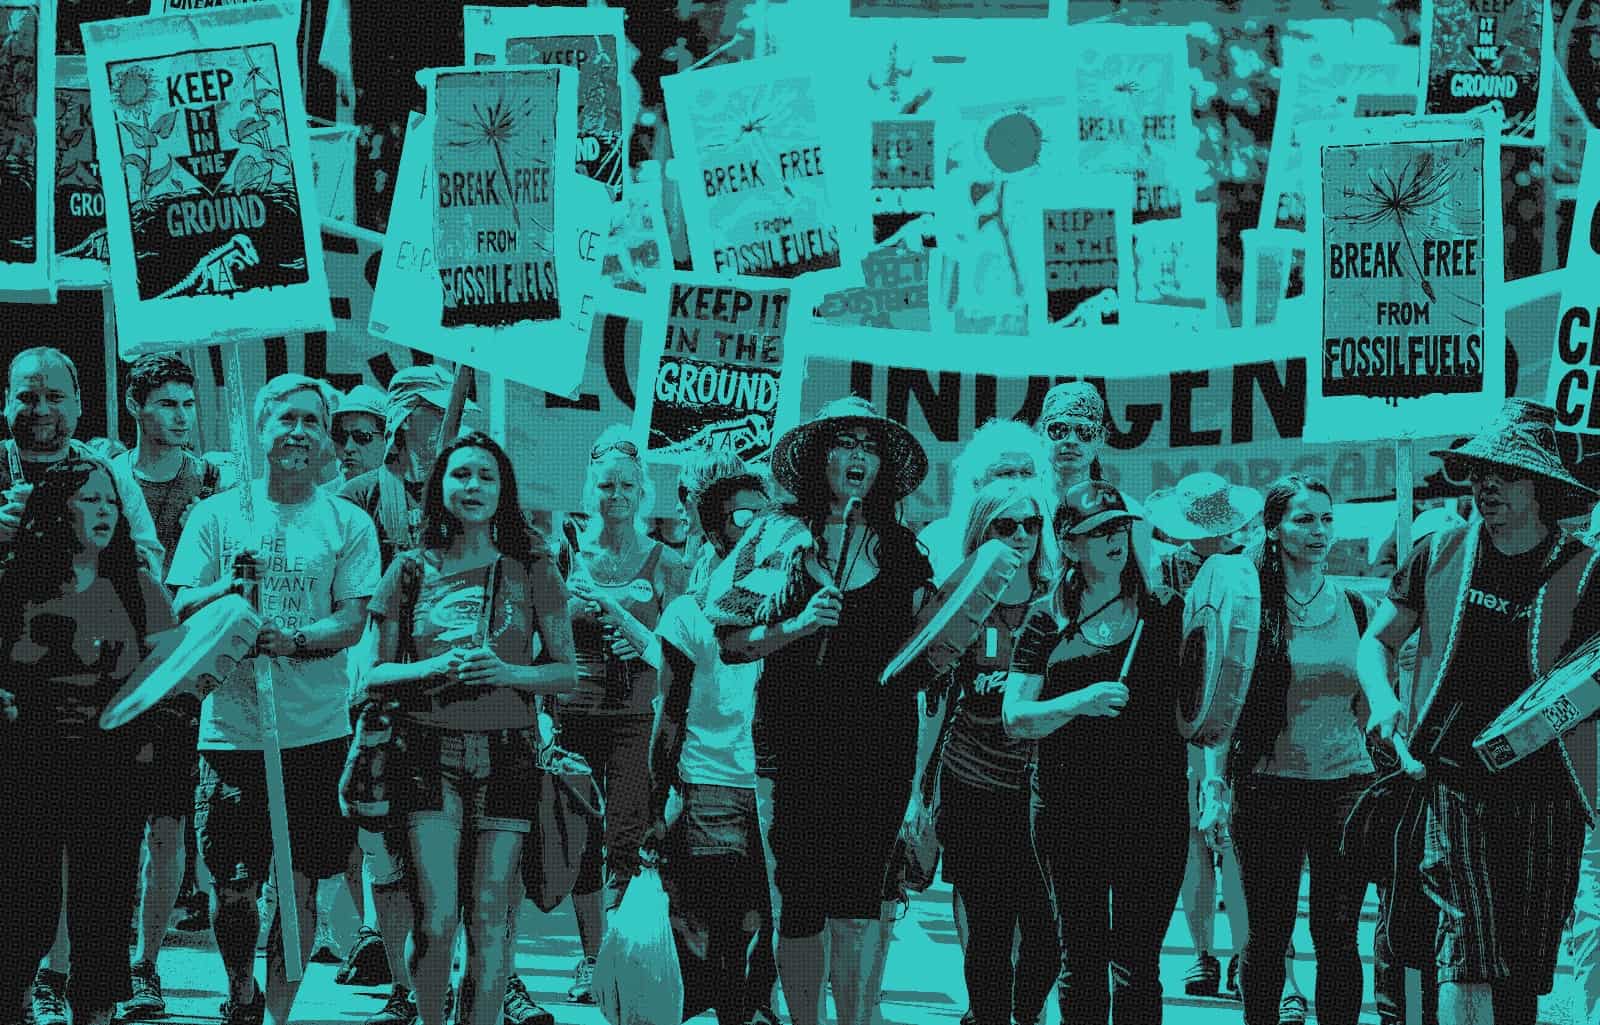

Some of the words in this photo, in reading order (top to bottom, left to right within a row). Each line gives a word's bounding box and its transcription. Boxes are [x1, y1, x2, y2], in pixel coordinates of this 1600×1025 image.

[1472, 46, 1499, 59] THE
[166, 68, 234, 107] KEEP
[1450, 72, 1519, 98] GROUND
[190, 110, 211, 131] IT
[193, 132, 215, 151] IN
[187, 153, 226, 175] THE
[703, 159, 765, 197] BREAK
[779, 147, 824, 180] FREE
[439, 169, 500, 208] BREAK
[514, 167, 551, 204] FREE
[165, 194, 267, 238] GROUND
[754, 216, 793, 234] FROM
[477, 229, 517, 253] FROM
[780, 224, 840, 266] FUELS
[1330, 241, 1405, 280] BREAK
[1423, 239, 1479, 277] FREE
[440, 264, 501, 306] FOSSIL
[503, 261, 556, 303] FUELS
[671, 284, 753, 325] KEEP
[758, 294, 788, 329] IT
[1377, 301, 1430, 326] FROM
[664, 324, 700, 354] IN
[714, 330, 782, 364] THE
[1325, 337, 1405, 378] FOSSIL
[1408, 334, 1481, 377] FUELS
[655, 361, 779, 412] GROUND
[263, 576, 318, 592] WANT
[283, 597, 301, 612] IN
